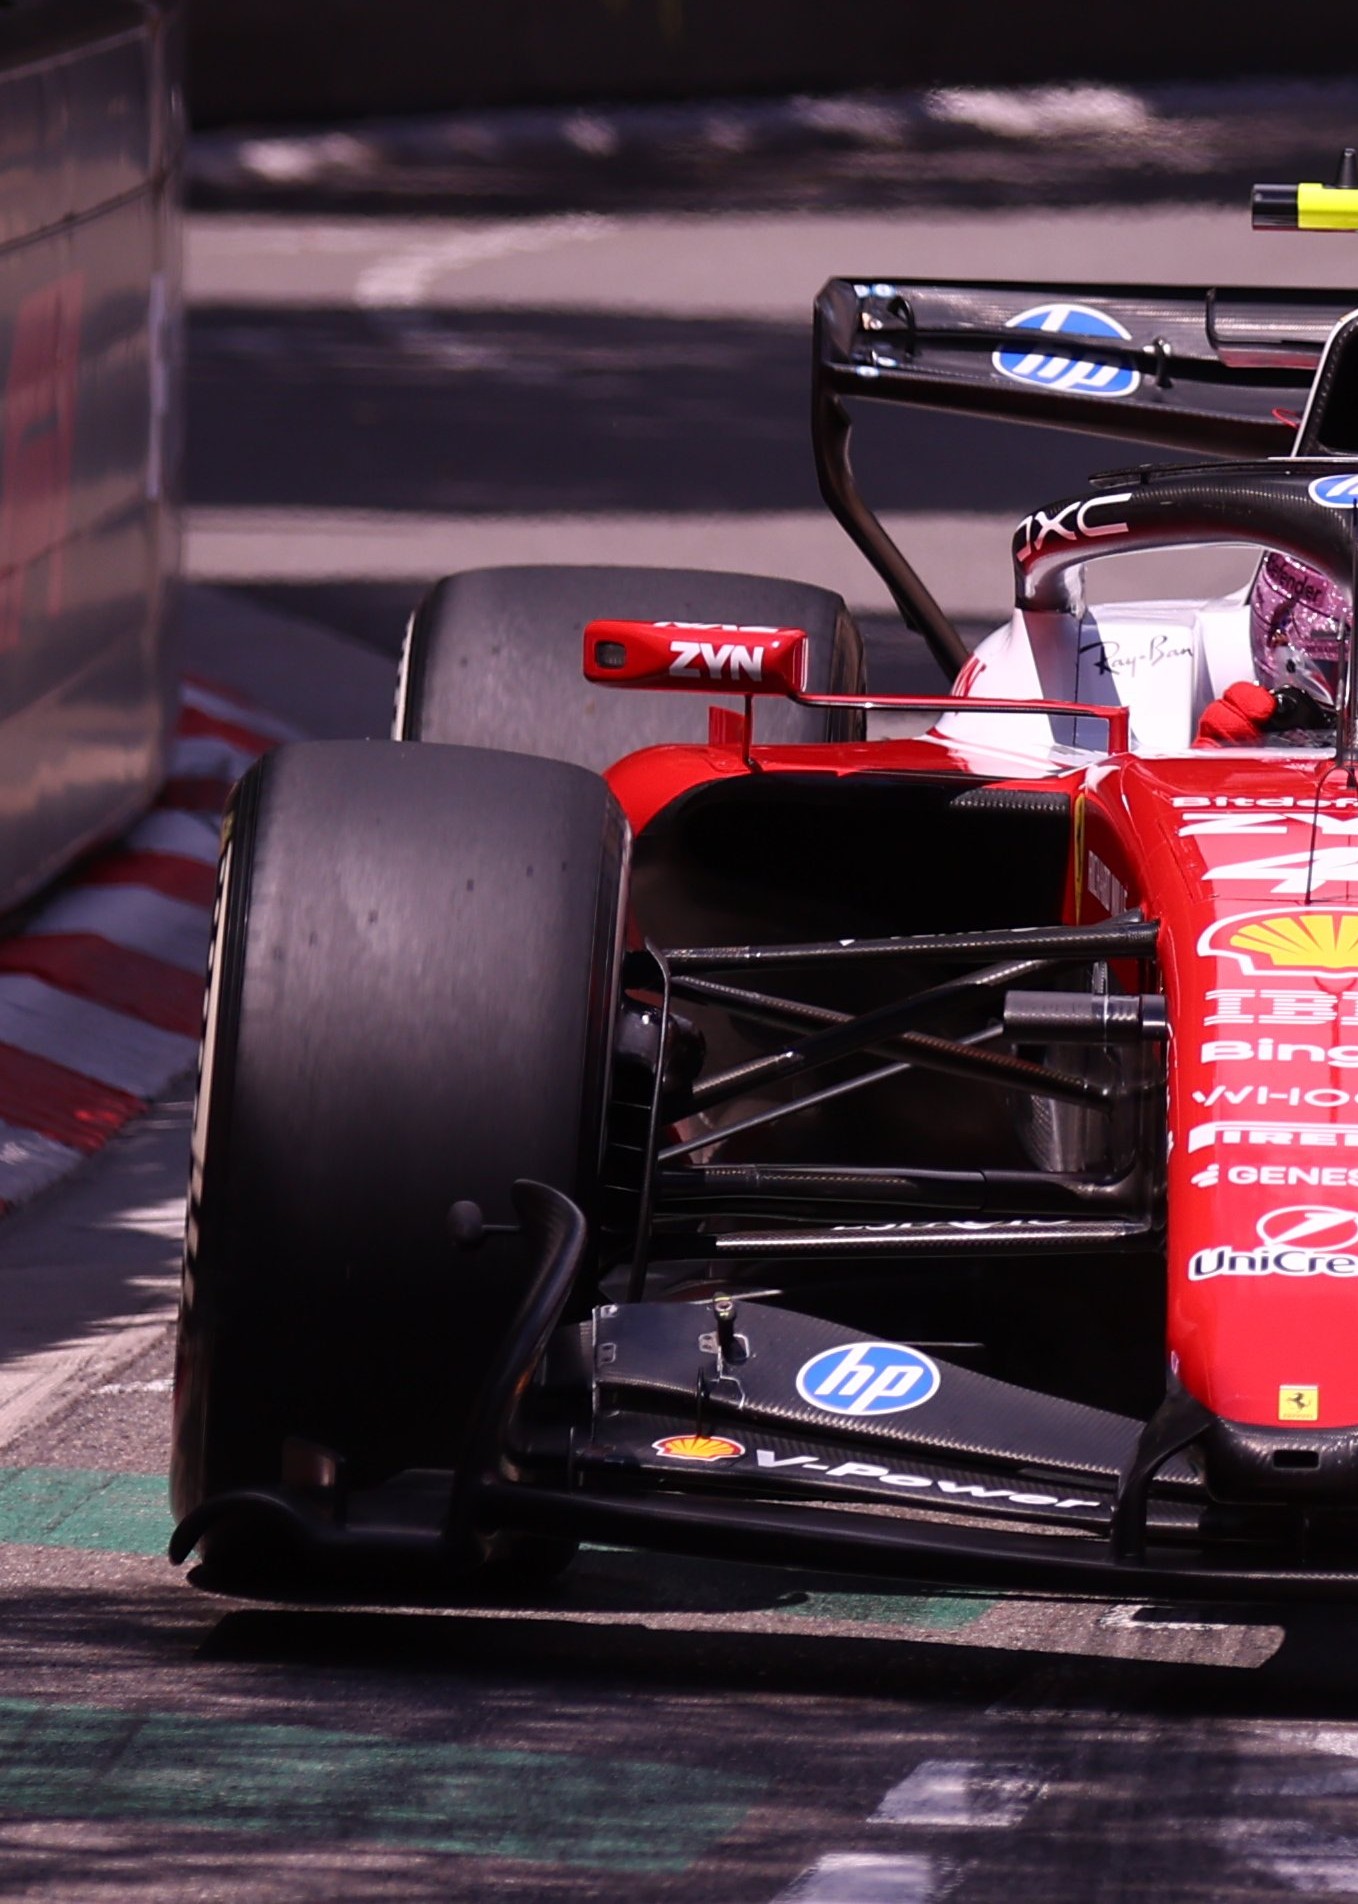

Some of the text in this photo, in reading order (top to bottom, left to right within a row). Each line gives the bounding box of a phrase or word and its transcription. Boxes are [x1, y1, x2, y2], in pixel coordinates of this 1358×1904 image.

[1010, 305, 1121, 390] hp
[668, 641, 765, 682] ZYN
[1078, 634, 1194, 677] Ray-Ban
[814, 1343, 924, 1414] hp
[755, 1449, 1101, 1510] V-Power
